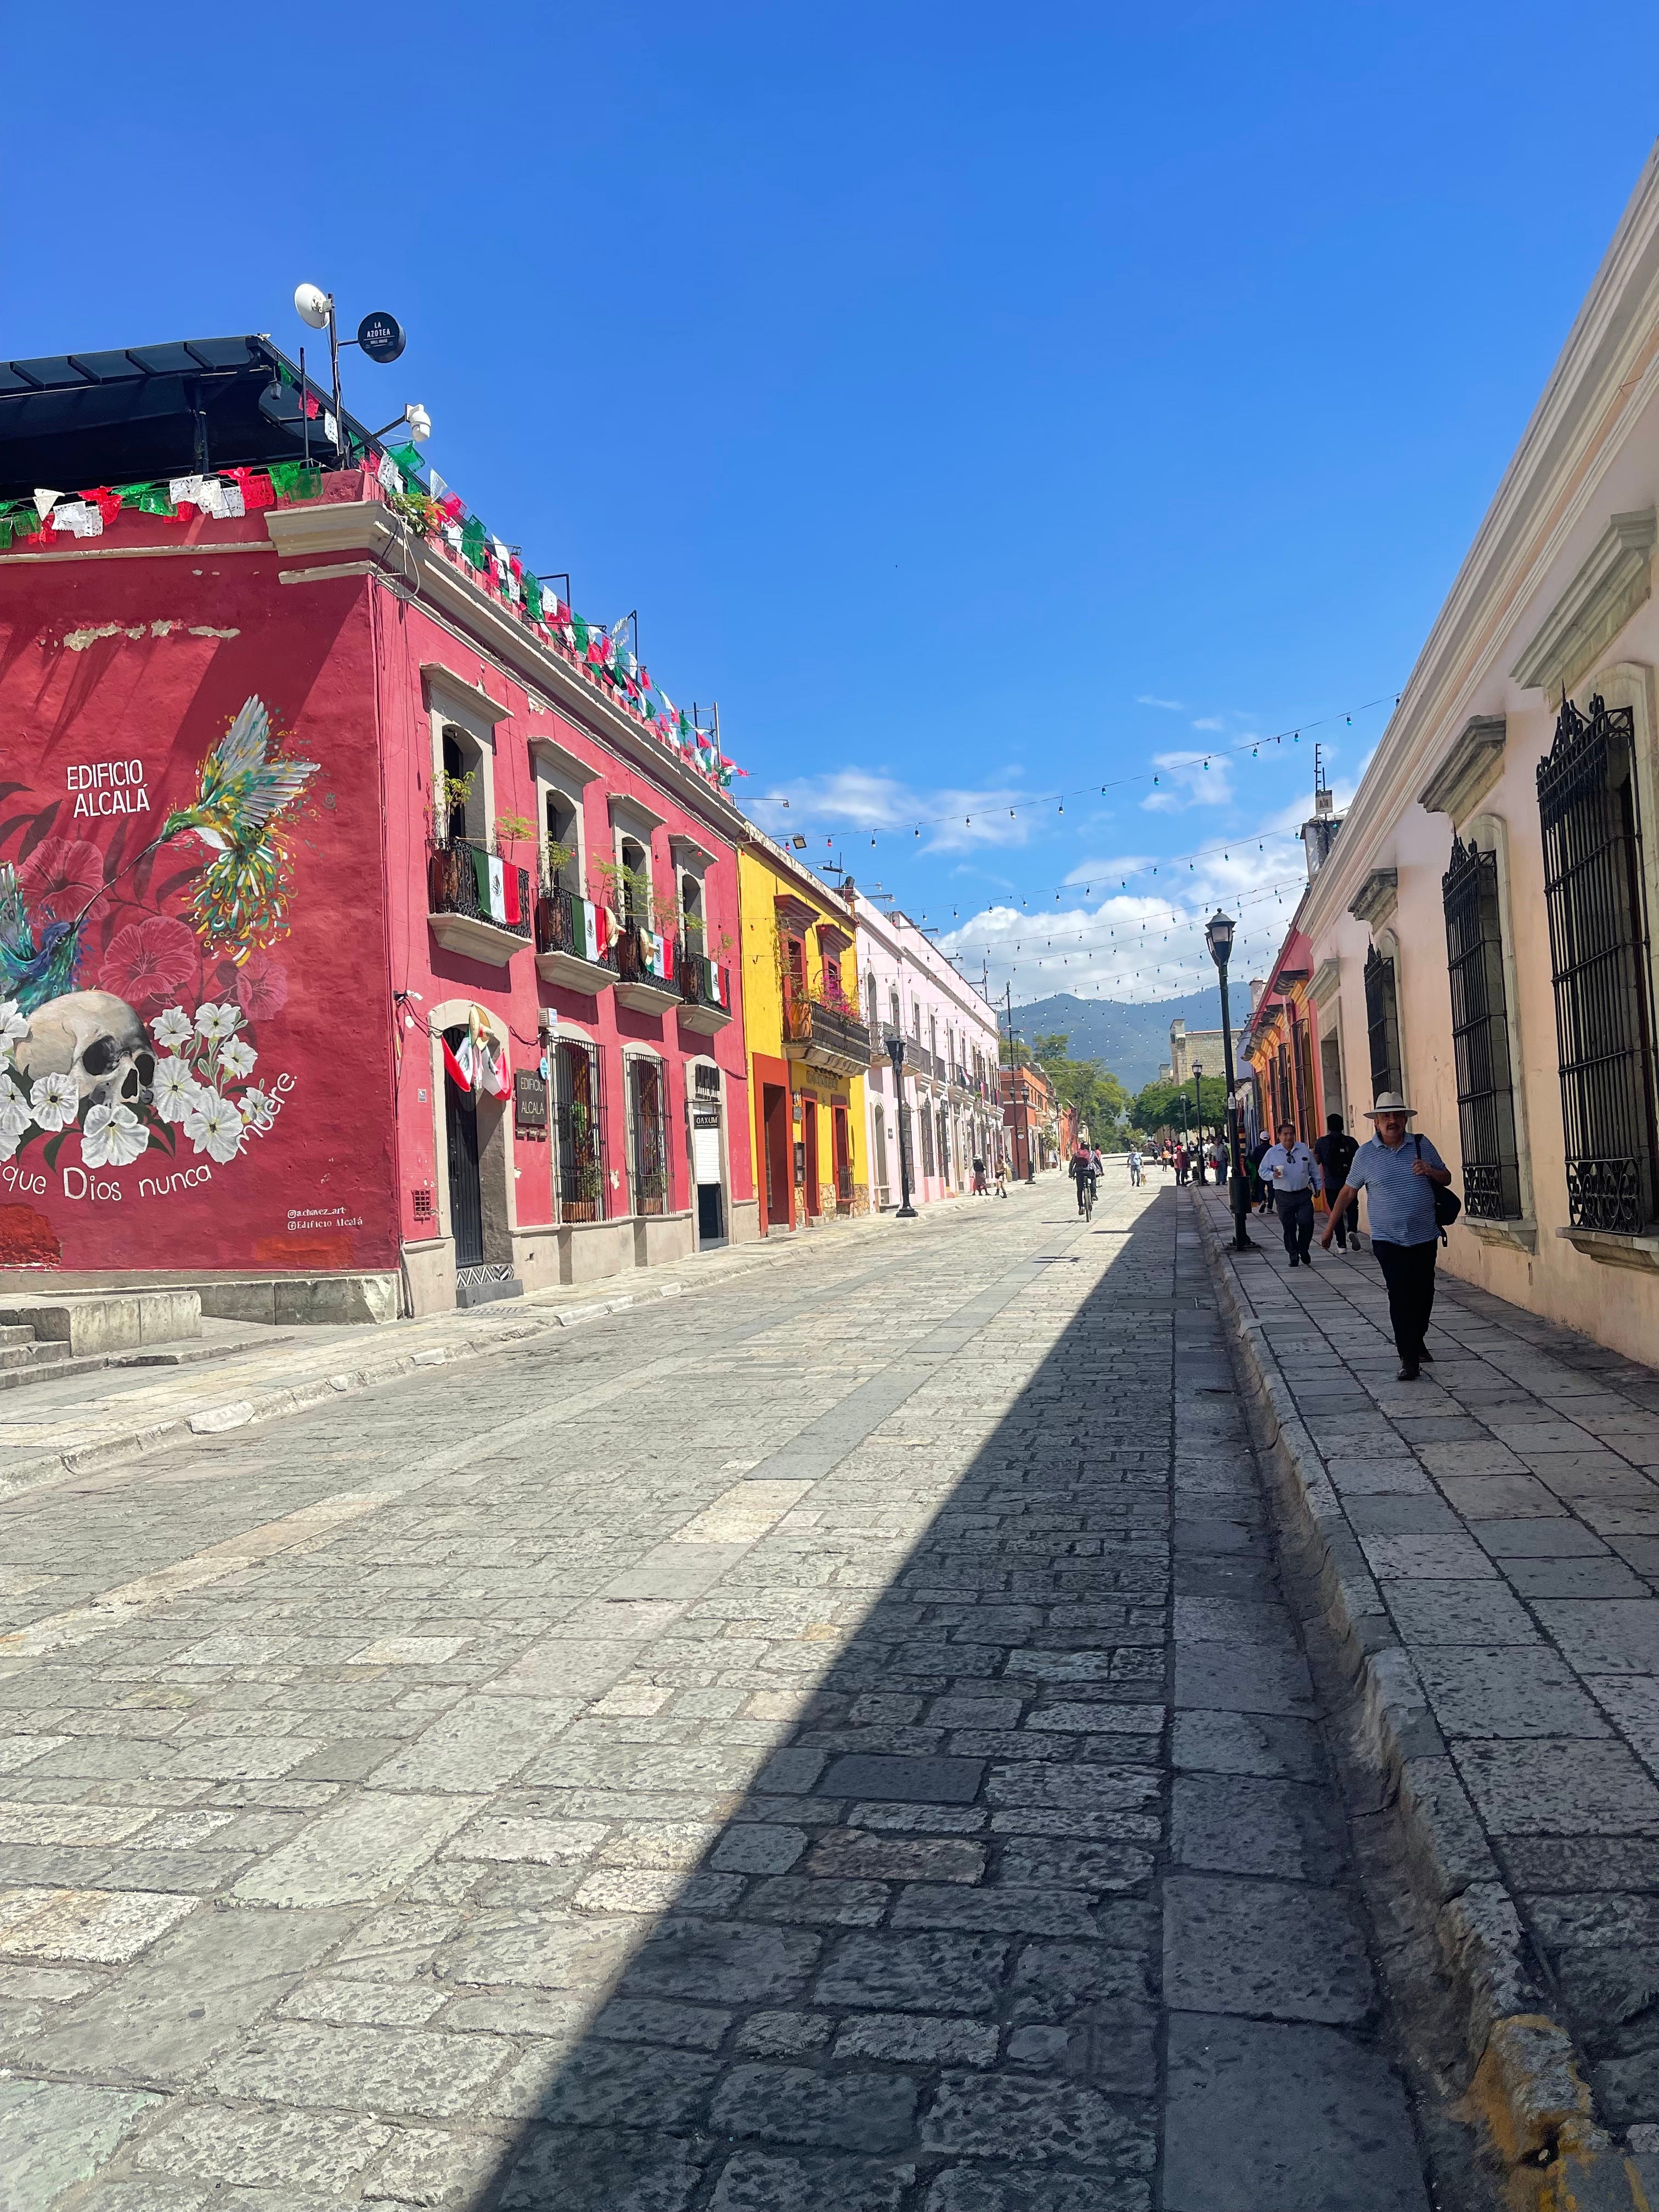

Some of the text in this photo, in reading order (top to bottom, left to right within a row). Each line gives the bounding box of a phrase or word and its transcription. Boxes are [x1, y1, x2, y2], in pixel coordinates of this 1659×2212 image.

[366, 328, 391, 338] AZOTEA
[67, 759, 143, 790] EDIFICIO
[73, 783, 150, 818] ALCALÁ
[521, 1101, 544, 1115] ALCALA
[696, 1116, 718, 1125] OAXUM
[63, 1167, 122, 1201] Dios
[138, 1164, 212, 1197] nunca
[236, 1073, 297, 1154] muere.
[297, 1216, 363, 1229] Edificio Alcalá
